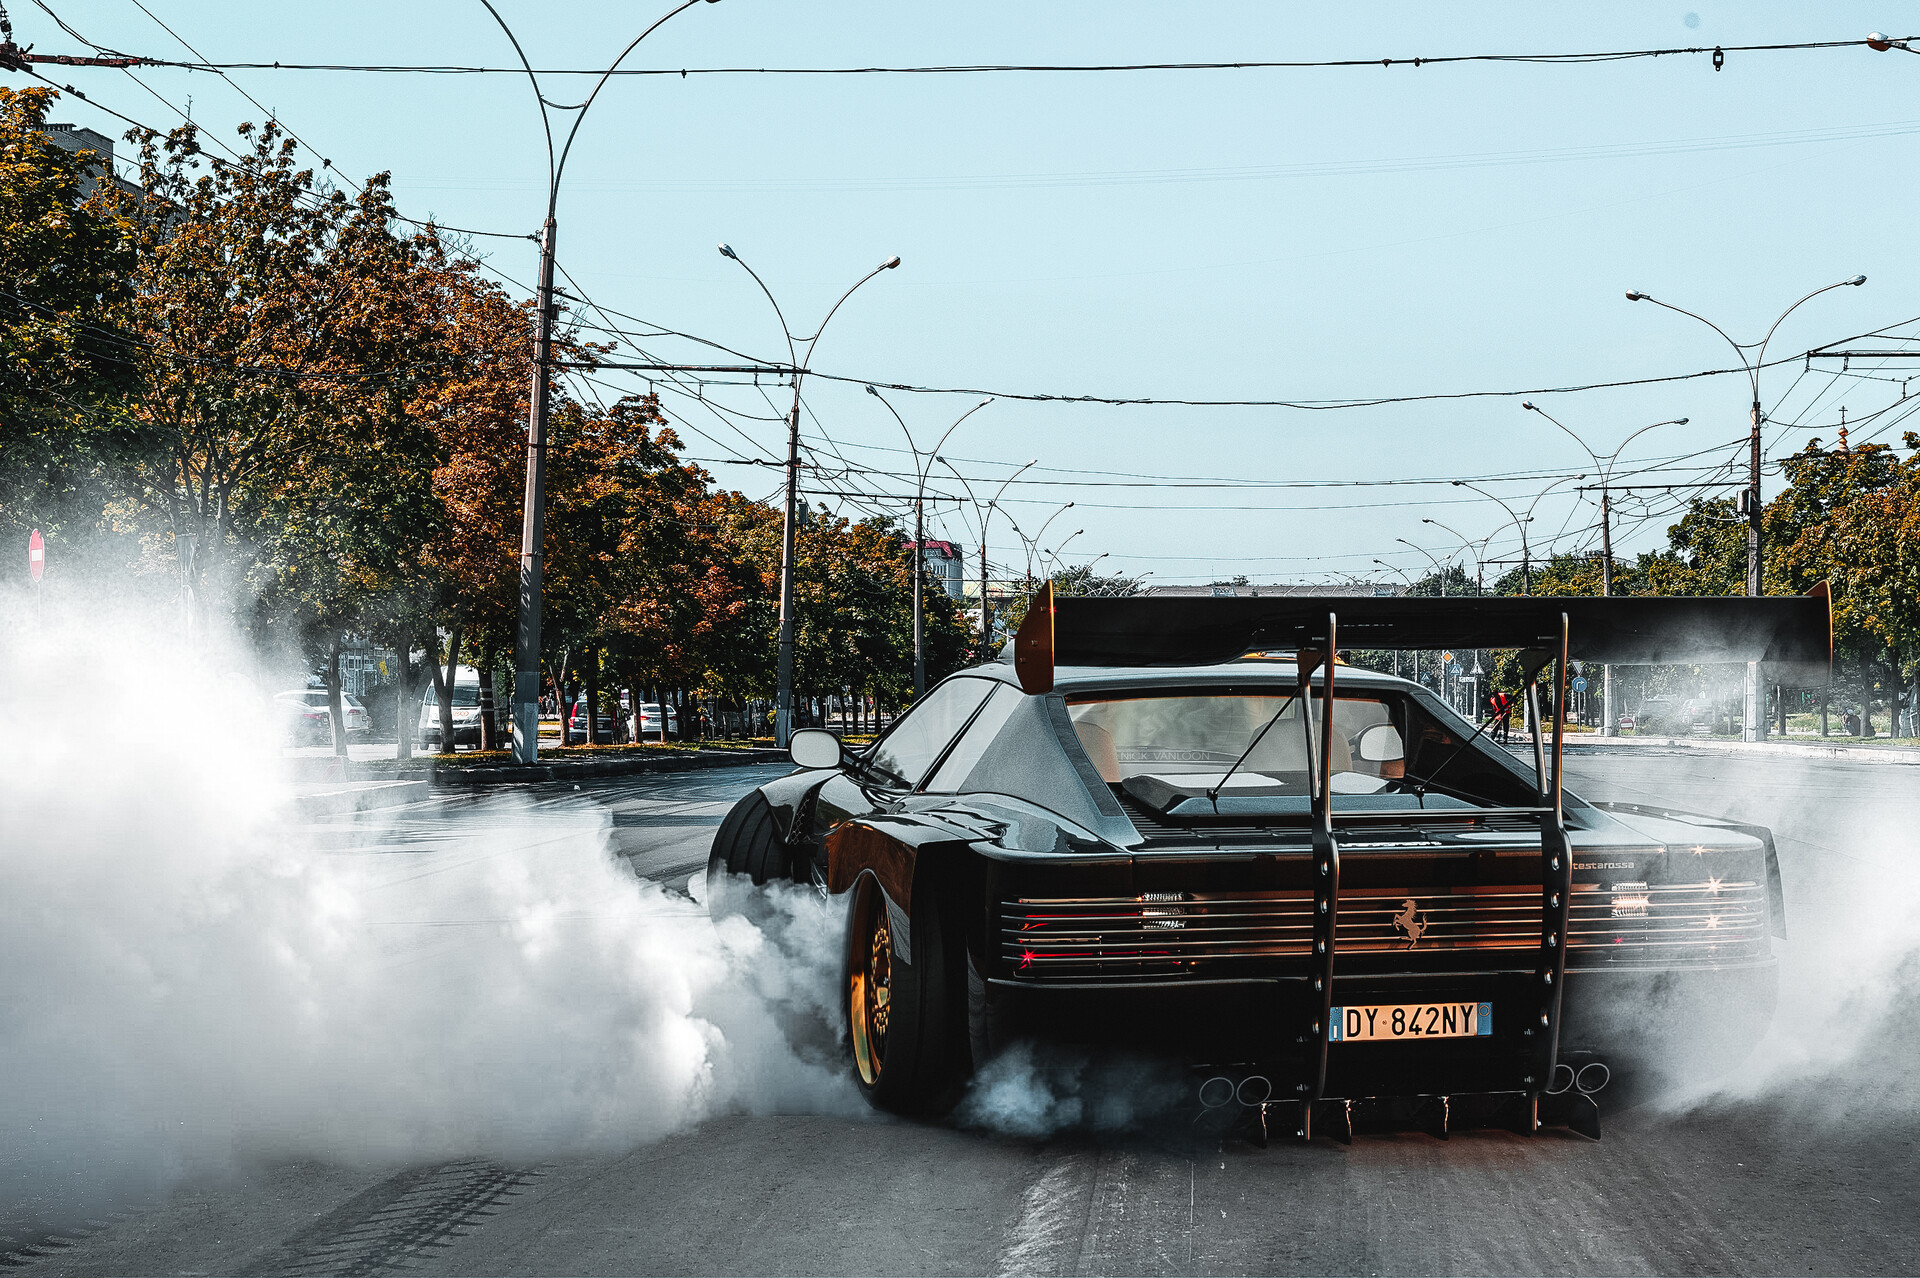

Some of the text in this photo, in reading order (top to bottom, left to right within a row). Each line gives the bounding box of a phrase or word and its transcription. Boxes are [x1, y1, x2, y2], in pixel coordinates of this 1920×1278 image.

[1573, 862, 1635, 870] testarossa
[1346, 1005, 1473, 1037] DY 842NY
